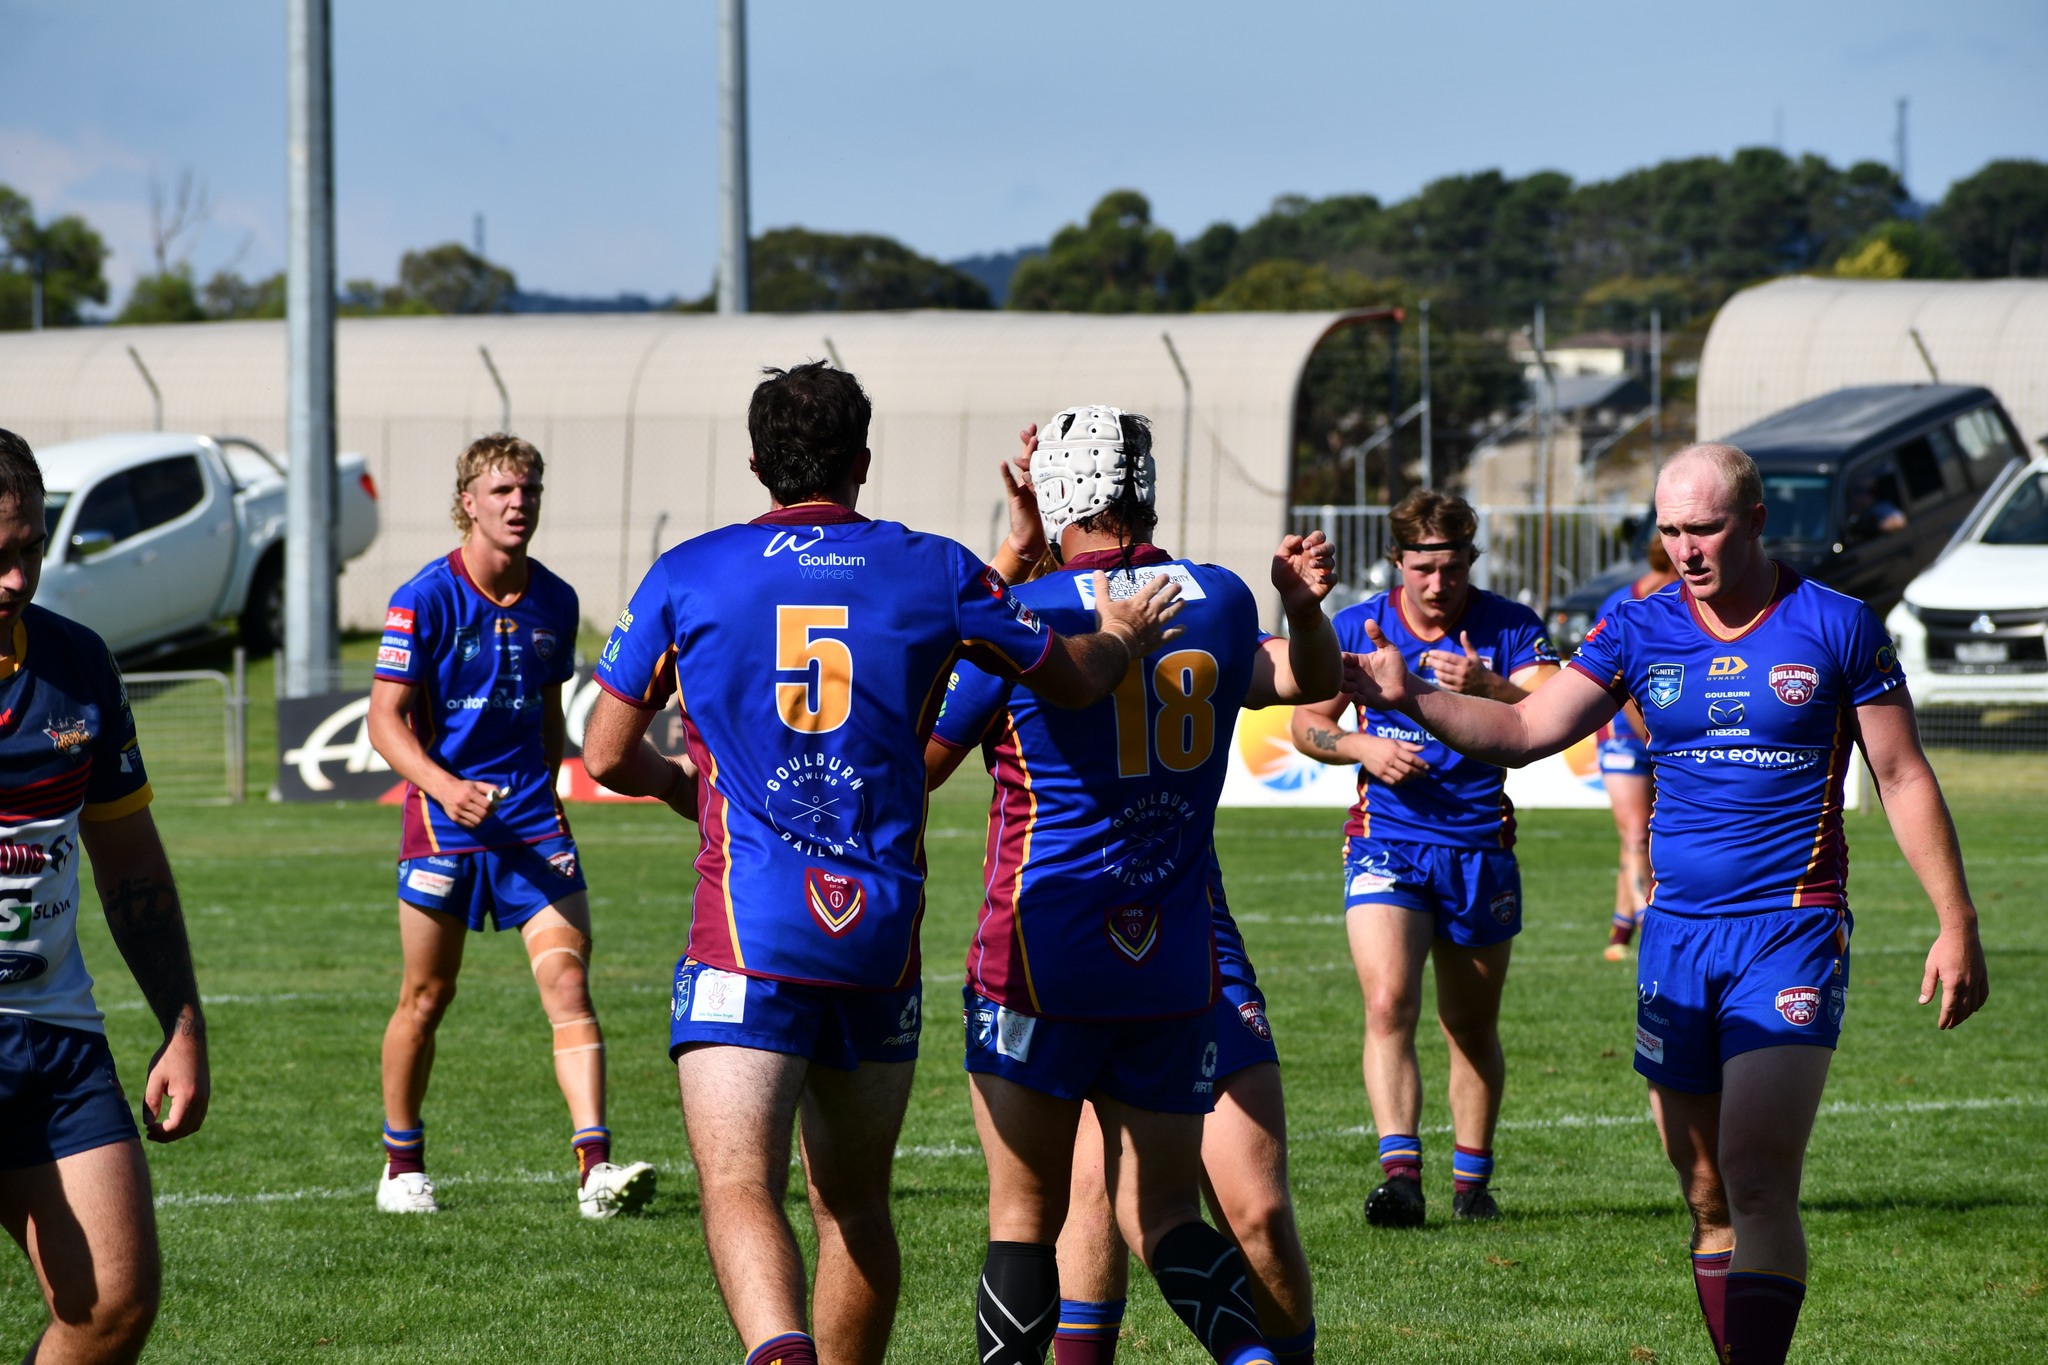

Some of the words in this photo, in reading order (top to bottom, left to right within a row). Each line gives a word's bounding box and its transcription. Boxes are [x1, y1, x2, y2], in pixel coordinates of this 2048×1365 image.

[799, 553, 865, 566] Goulburn
[799, 567, 855, 579] Workers
[776, 604, 854, 735] 5
[1771, 669, 1817, 685] BULLDOGS
[1705, 690, 1750, 699] GOULBURN
[1113, 648, 1219, 779] 18
[1706, 728, 1750, 737] mazda
[1728, 747, 1820, 763] edwards
[766, 753, 864, 791] GOULBURN
[792, 772, 838, 787] BOWLING
[1777, 992, 1820, 1007] BULLDOGS
[975, 1011, 992, 1023] NSW
[1643, 1007, 1670, 1027] Goulburn
